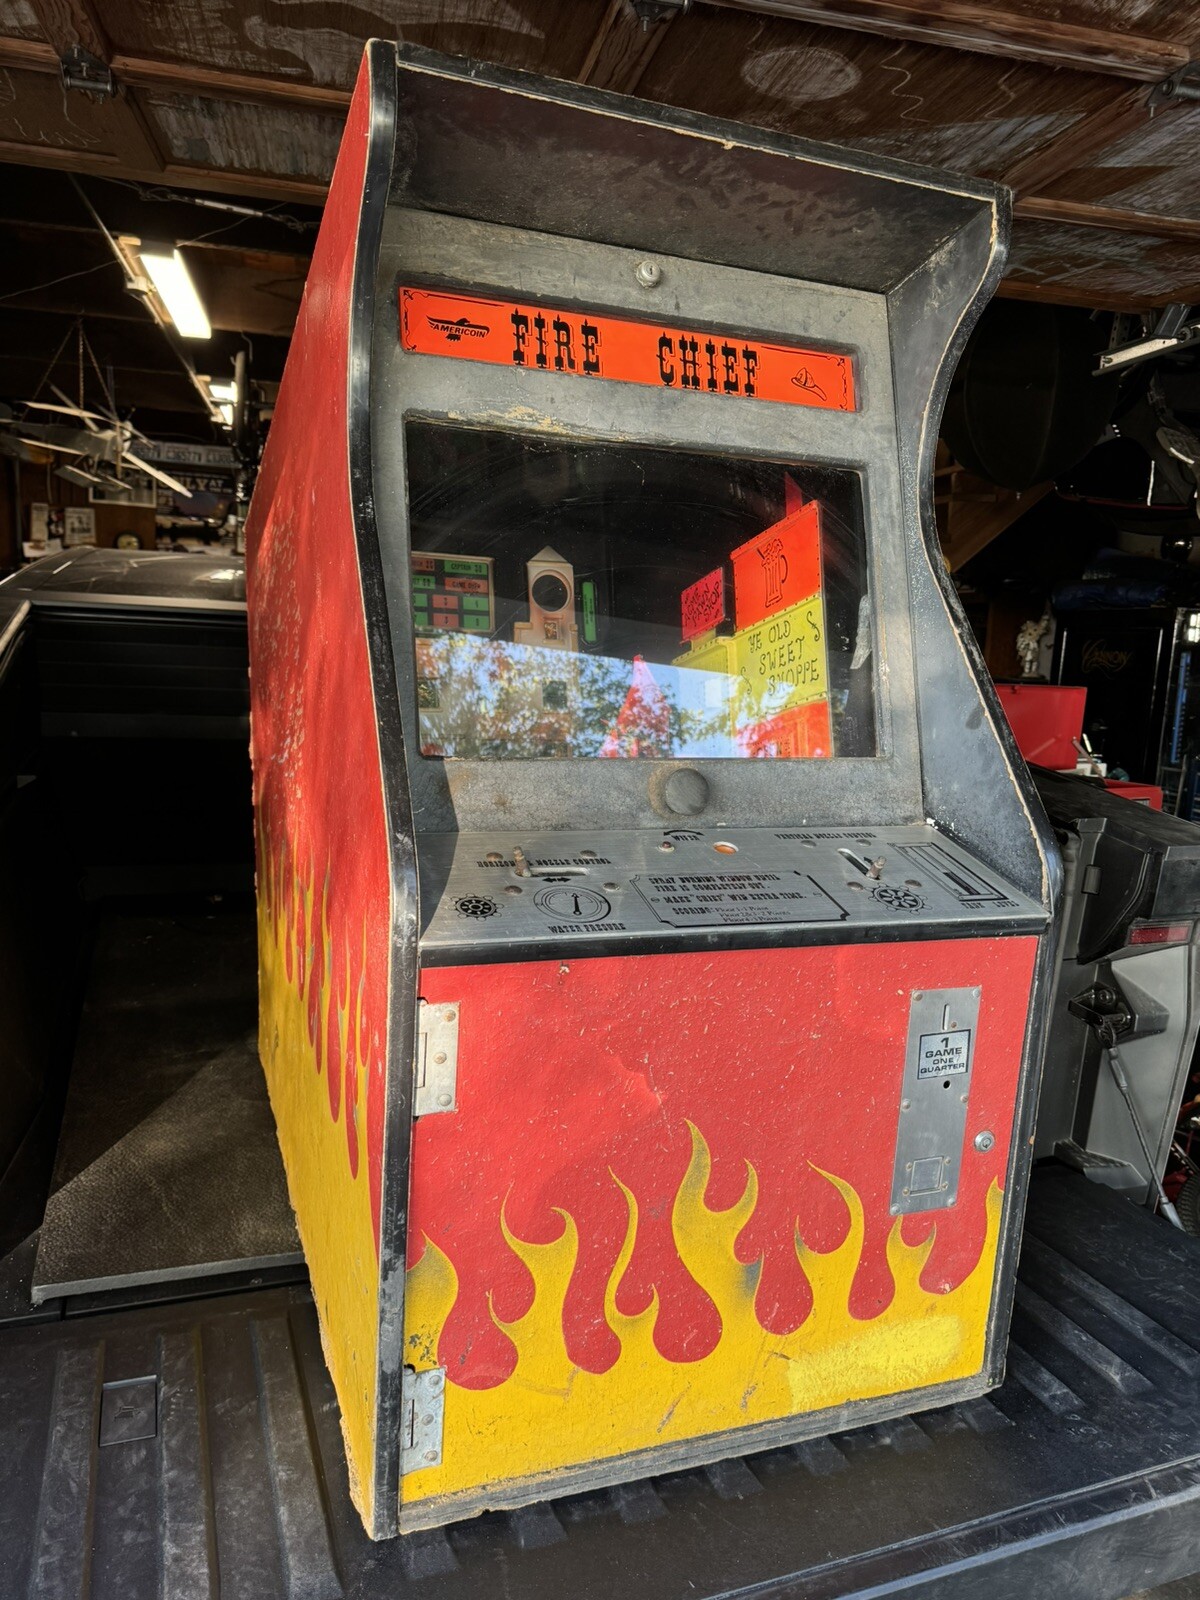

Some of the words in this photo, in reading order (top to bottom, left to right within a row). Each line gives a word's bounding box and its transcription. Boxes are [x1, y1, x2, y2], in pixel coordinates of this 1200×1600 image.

[432, 323, 486, 339] AMERICOIN
[510, 306, 604, 375] FIRE
[656, 331, 760, 398] CHIEF
[692, 583, 710, 627] PAWN
[704, 581, 720, 620] SHOP
[747, 631, 763, 655] YE
[768, 619, 792, 644] OLD
[759, 637, 805, 676] SWEET
[767, 657, 820, 697] SHOPPE
[842, 831, 877, 839] CONTROL
[476, 858, 535, 868] HORIZONL
[535, 858, 571, 866] NOZZLE
[572, 857, 612, 866] CONTROL
[649, 877, 675, 885] SPRAY
[679, 875, 715, 885] BURNING
[716, 875, 753, 884] WINDOW
[753, 873, 781, 882] UNTIL
[655, 884, 677, 892] FIRE
[680, 884, 690, 892] IS
[692, 882, 747, 892] COMPLETELY
[664, 895, 691, 904] MAKE
[727, 893, 748, 902] WIN
[748, 892, 780, 901] EXTRA
[780, 891, 807, 900] TIME.
[547, 924, 583, 934] WATER
[940, 1036, 950, 1049] 1
[925, 1046, 963, 1059] GAME
[920, 1062, 966, 1074] QUARTER
[932, 1057, 954, 1066] ONE
